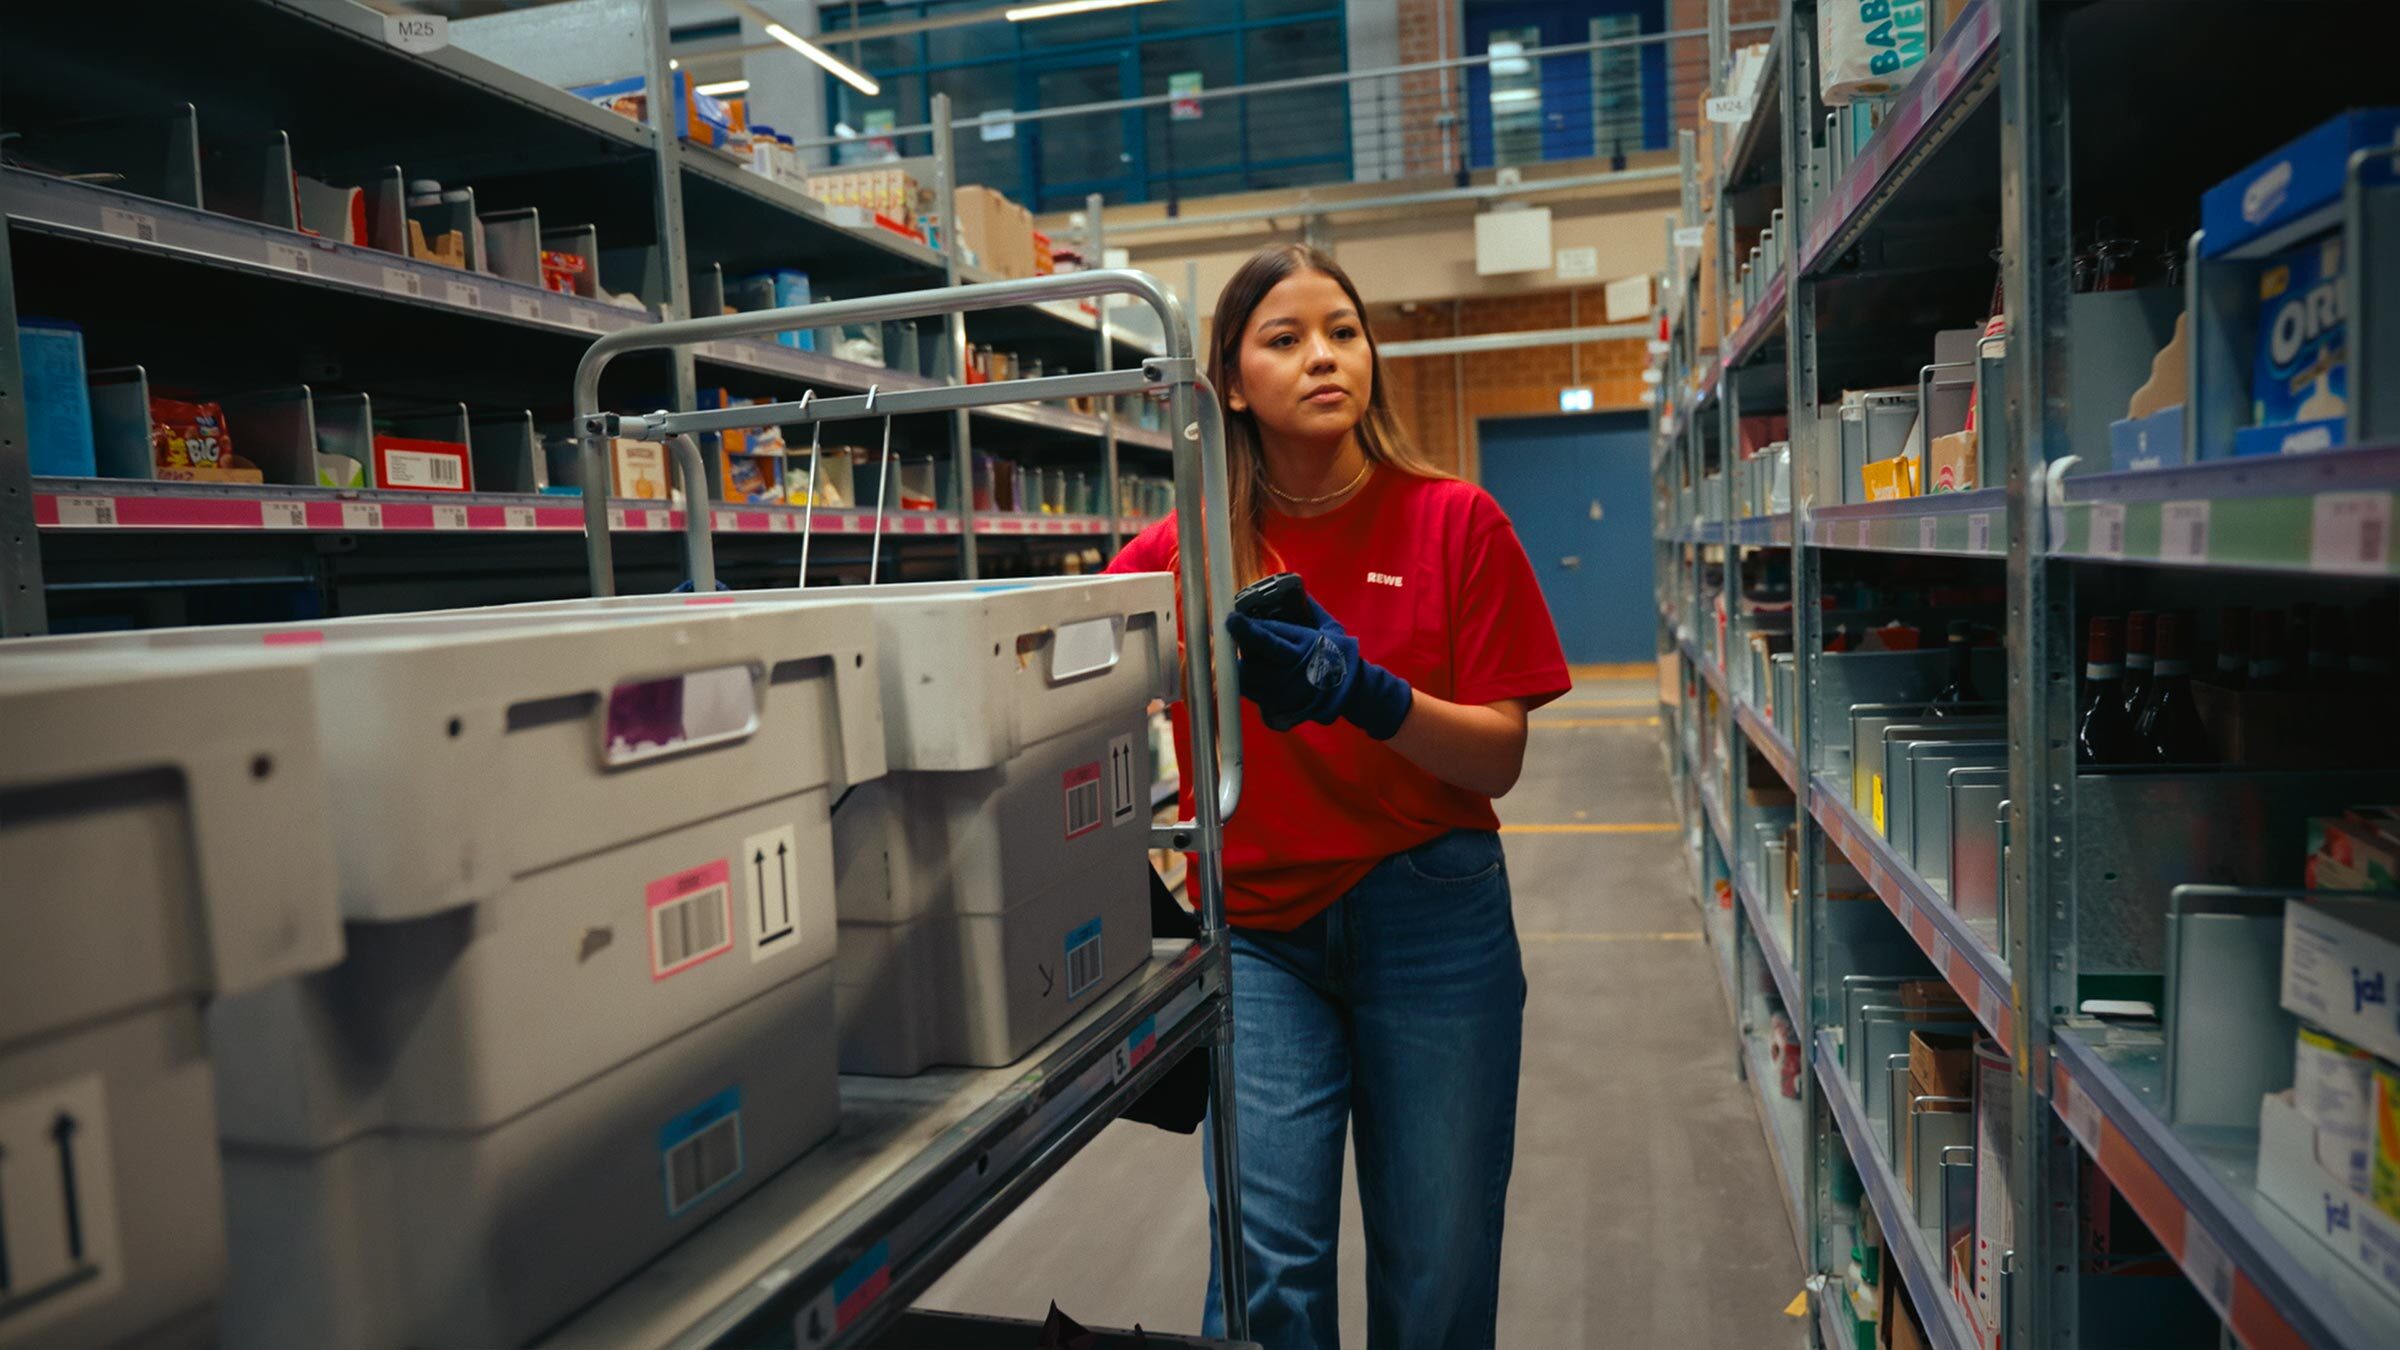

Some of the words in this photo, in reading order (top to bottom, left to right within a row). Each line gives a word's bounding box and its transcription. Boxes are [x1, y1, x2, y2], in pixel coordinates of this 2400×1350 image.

[398, 22, 434, 37] M25
[1859, 0, 1900, 76] BAB
[1892, 0, 1926, 68] WE
[186, 436, 221, 464] BIG
[1367, 571, 1403, 587] REWE
